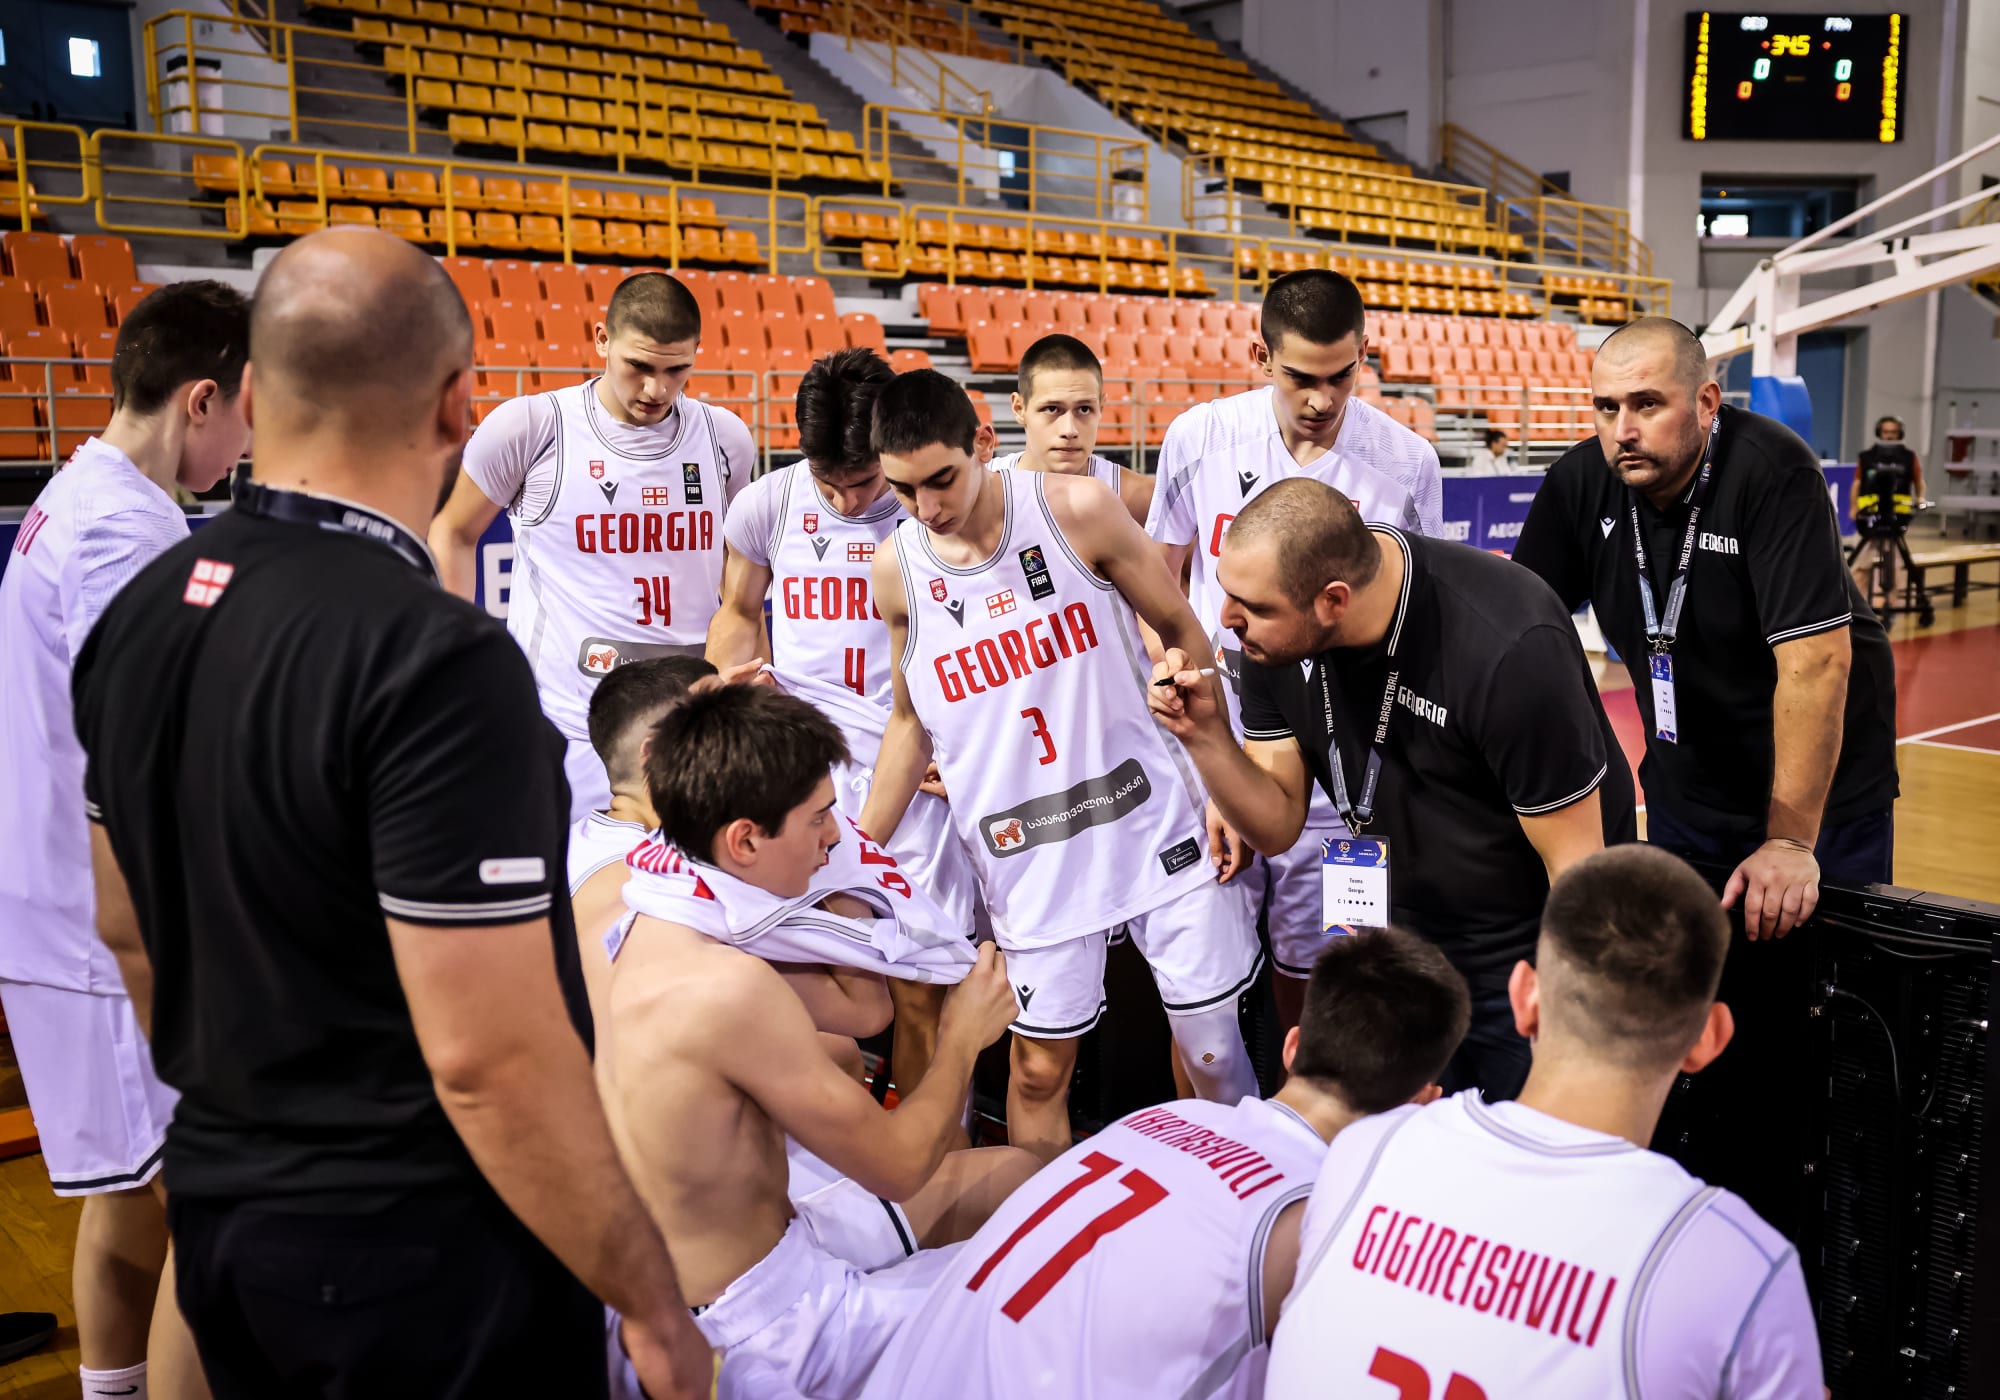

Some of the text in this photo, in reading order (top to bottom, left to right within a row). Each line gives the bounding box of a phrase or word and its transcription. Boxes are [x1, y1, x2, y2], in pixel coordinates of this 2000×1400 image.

[1737, 81, 1753, 99] 0
[1753, 58, 1771, 80] 0
[1835, 59, 1853, 81] 0
[1836, 82, 1852, 100] 0
[575, 511, 714, 555] GEORGIA
[1678, 506, 1701, 571] FIBA.BASKETBALL
[633, 575, 672, 627] 34
[783, 576, 880, 620] GEOR
[1031, 574, 1048, 588] FIBA
[844, 647, 866, 697] 4
[933, 602, 1099, 703] GEORGIA
[1375, 671, 1399, 744] FIBA.BASKETBALL
[1397, 685, 1448, 728] GEORGIA
[1020, 706, 1057, 766] 3
[967, 1151, 1169, 1323] 17
[1352, 1205, 1617, 1348] GIGINEISHVILI
